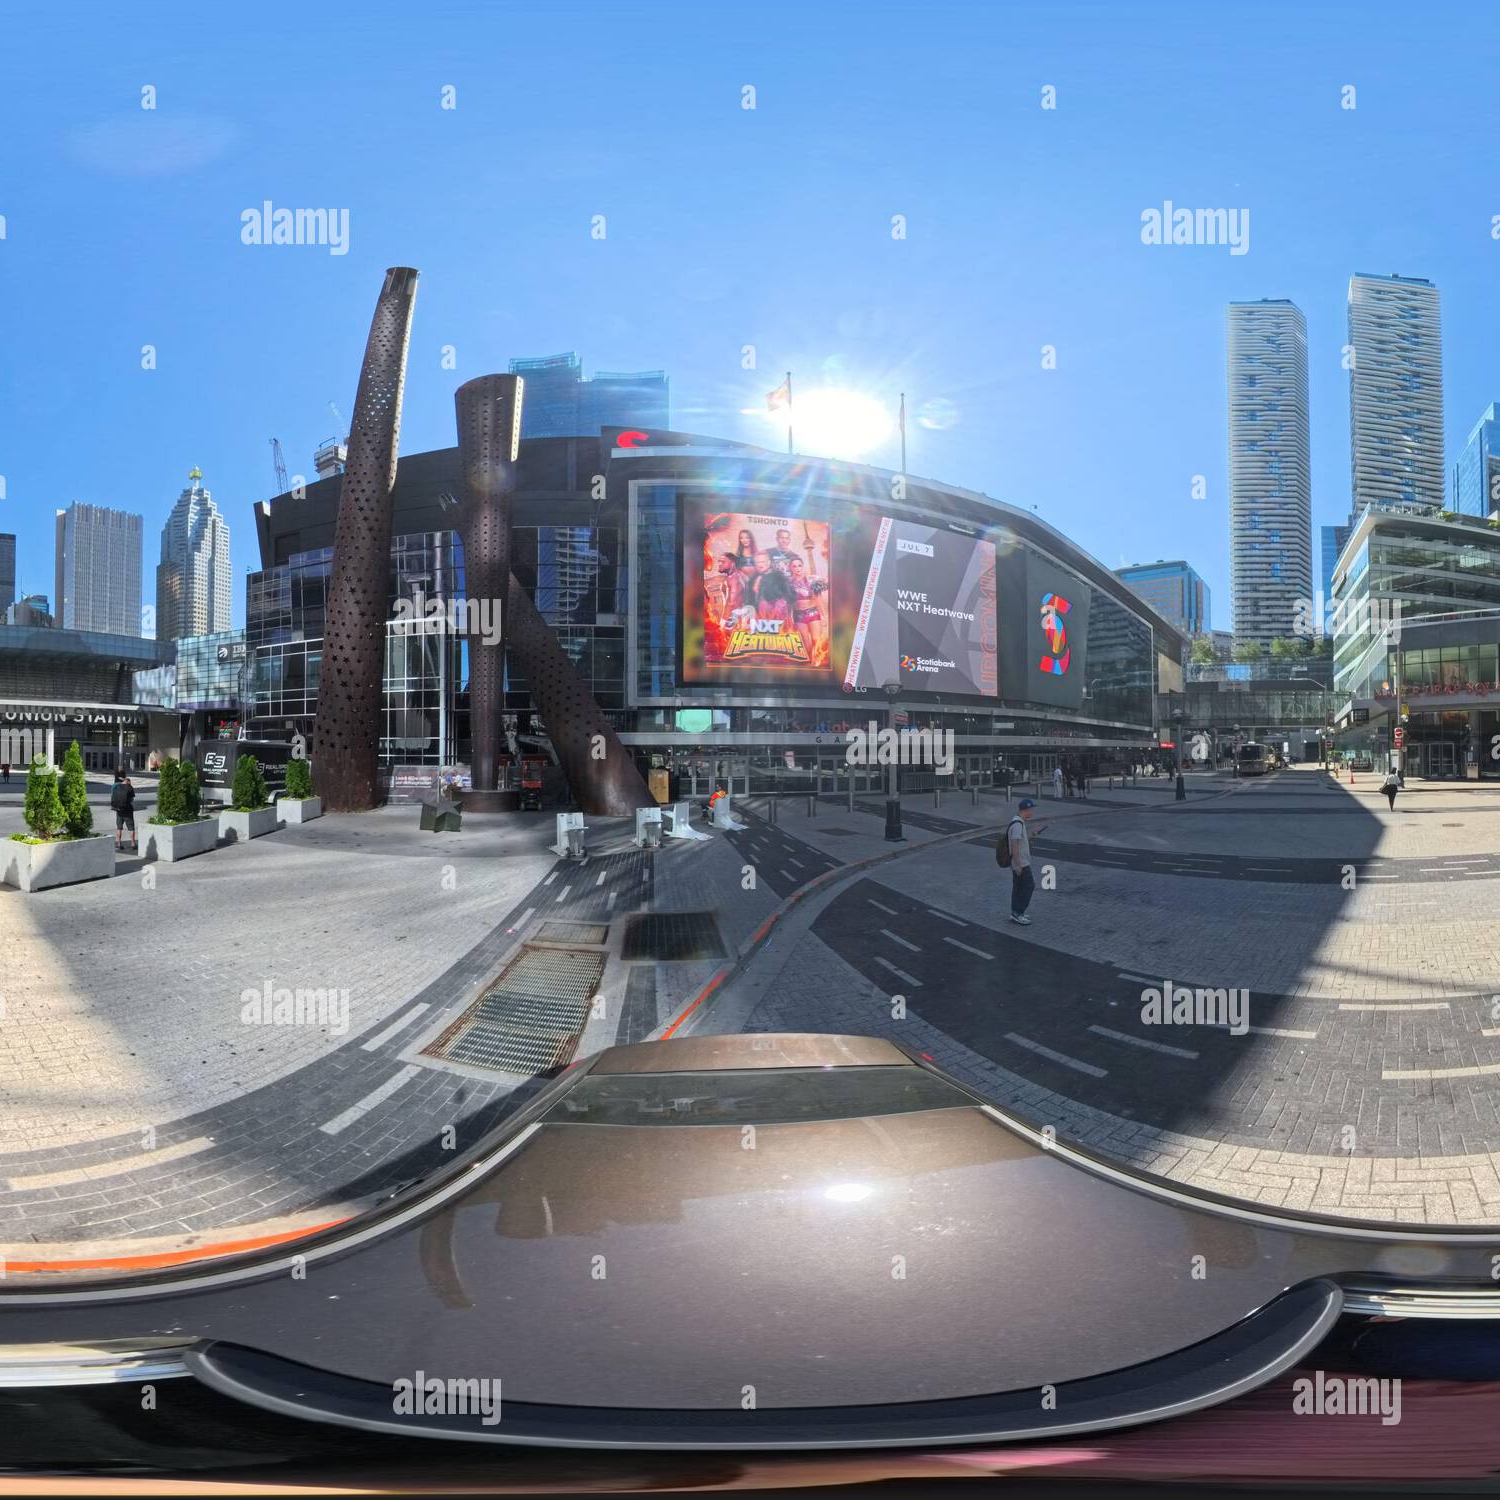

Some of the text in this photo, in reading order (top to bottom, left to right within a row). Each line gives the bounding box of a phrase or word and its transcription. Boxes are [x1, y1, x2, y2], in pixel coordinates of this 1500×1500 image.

[901, 543, 920, 552] JUL
[897, 589, 928, 603] WWE
[897, 600, 975, 622] NXT Heatwave
[916, 657, 956, 668] Scotiabank
[916, 664, 939, 673] Arena
[855, 684, 867, 693] LG
[5, 704, 144, 725] UNION STATION
